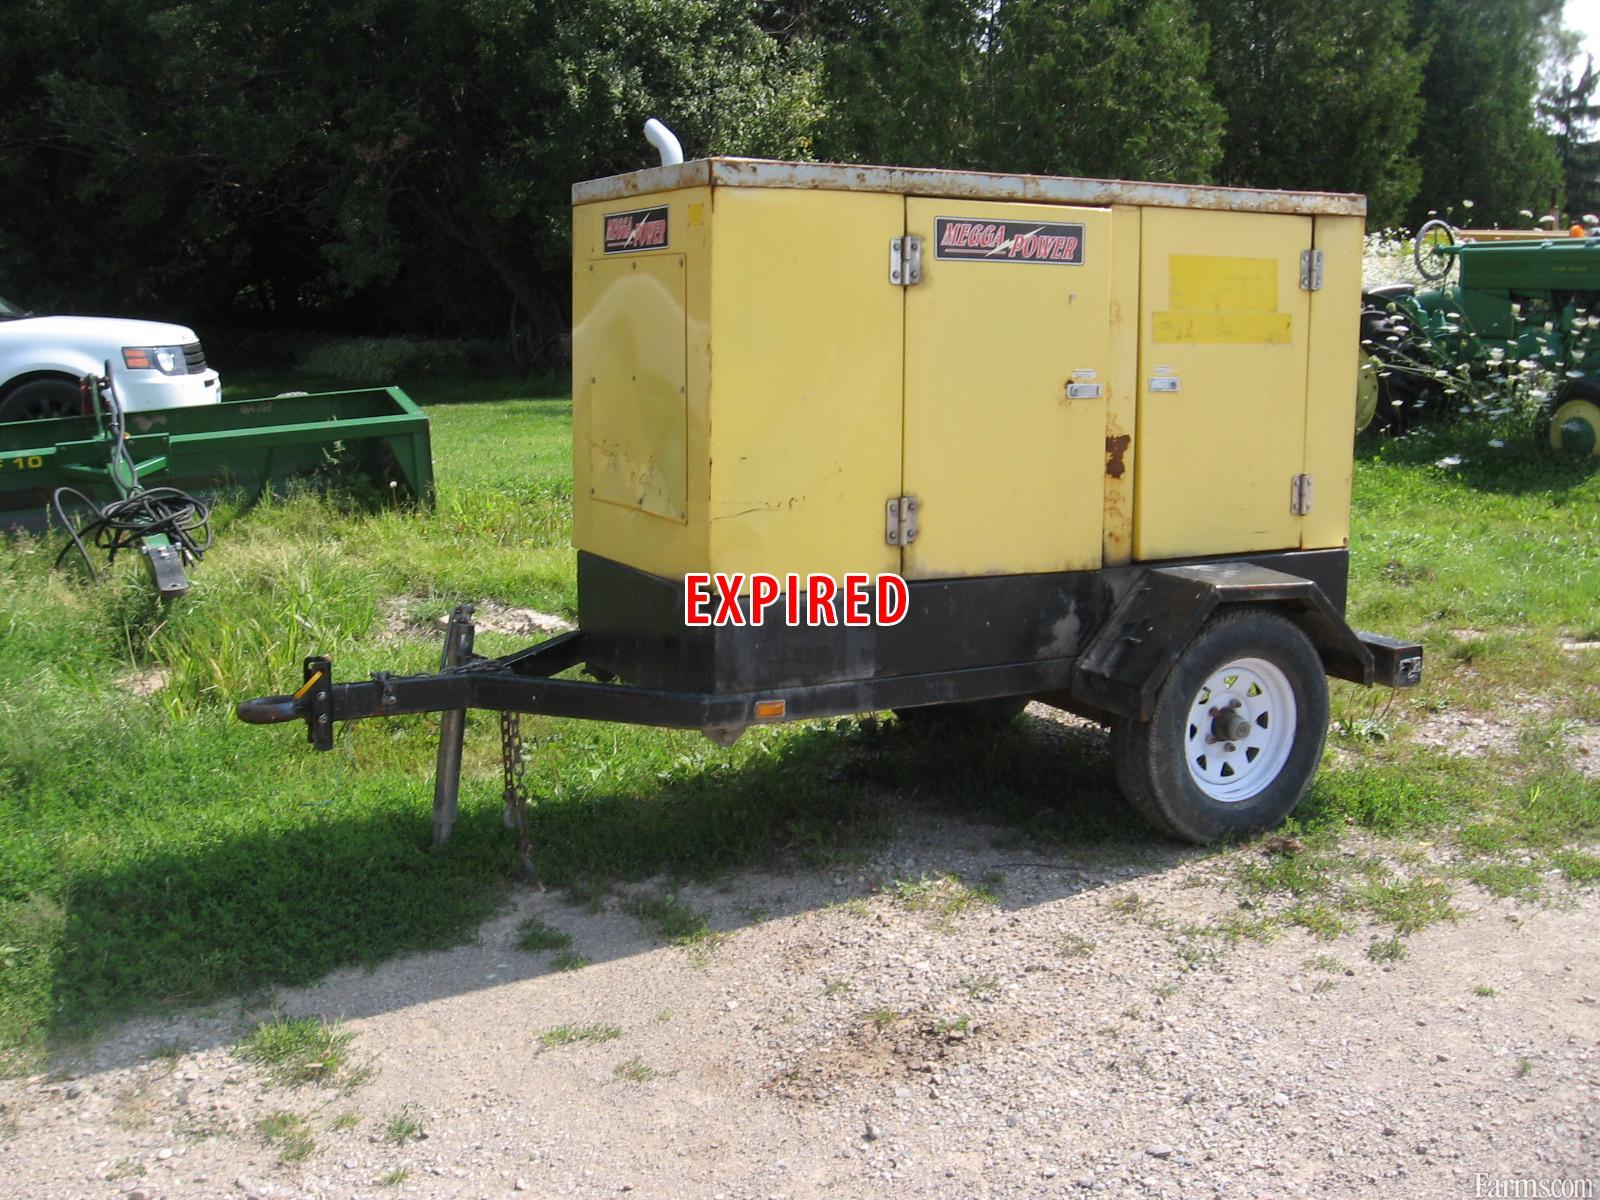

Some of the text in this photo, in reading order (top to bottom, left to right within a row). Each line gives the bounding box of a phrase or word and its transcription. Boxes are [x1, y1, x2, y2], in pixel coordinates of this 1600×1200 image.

[634, 219, 666, 246] POWER
[942, 223, 1078, 260] MEGGA POWER
[13, 456, 43, 470] 10
